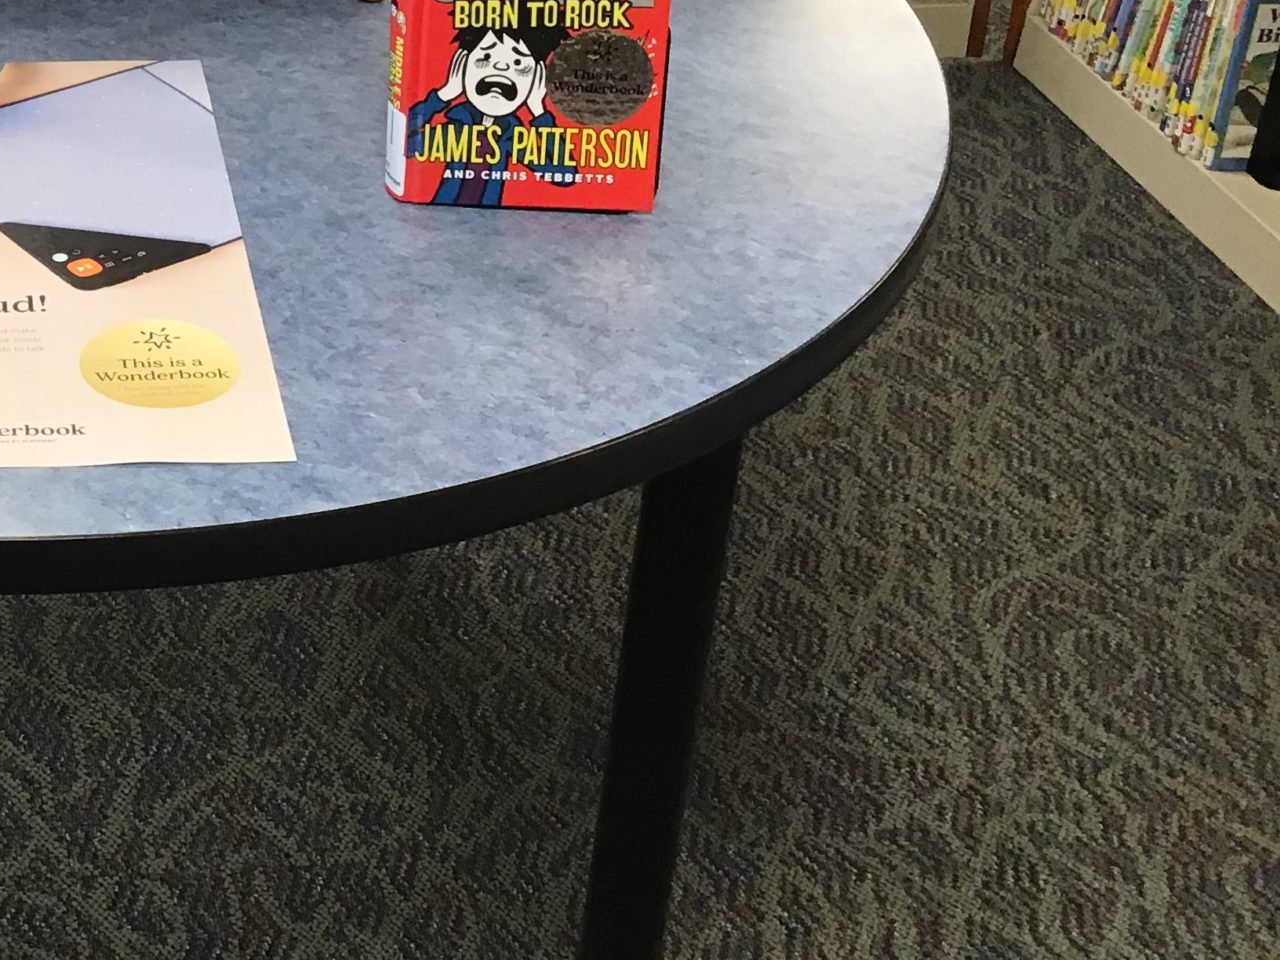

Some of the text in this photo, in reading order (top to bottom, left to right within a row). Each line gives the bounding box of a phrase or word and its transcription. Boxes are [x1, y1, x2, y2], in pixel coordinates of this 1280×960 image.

[527, 0, 558, 28] TO
[565, 0, 631, 29] ROCK
[415, 124, 649, 169] JAMES PATTERSON
[443, 169, 614, 184] AND CHRIS TEBBETTS
[119, 358, 203, 369] This is a
[95, 368, 231, 383] Wonderbook
